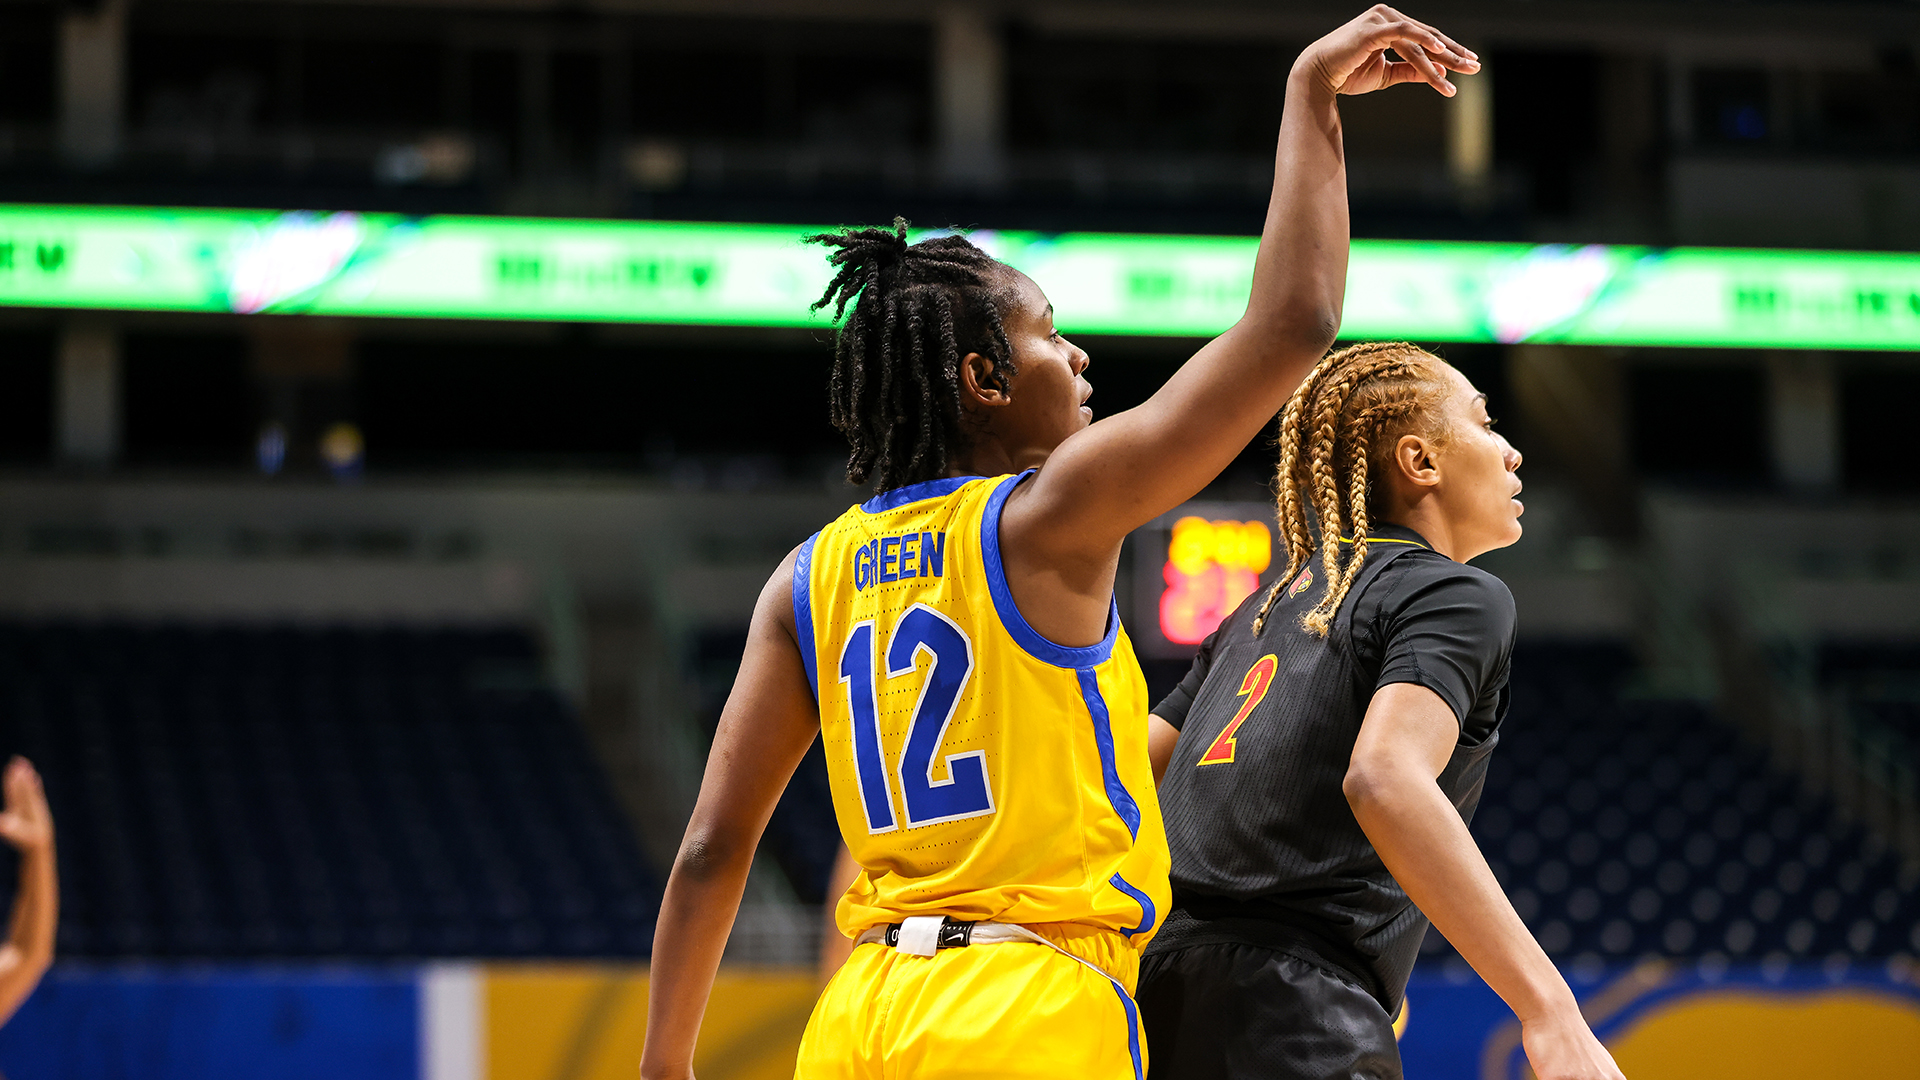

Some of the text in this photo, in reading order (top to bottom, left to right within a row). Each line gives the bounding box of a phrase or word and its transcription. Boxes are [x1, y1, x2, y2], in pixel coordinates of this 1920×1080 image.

[854, 531, 945, 592] GREEN
[838, 602, 996, 835] 12
[1196, 653, 1279, 767] 2
